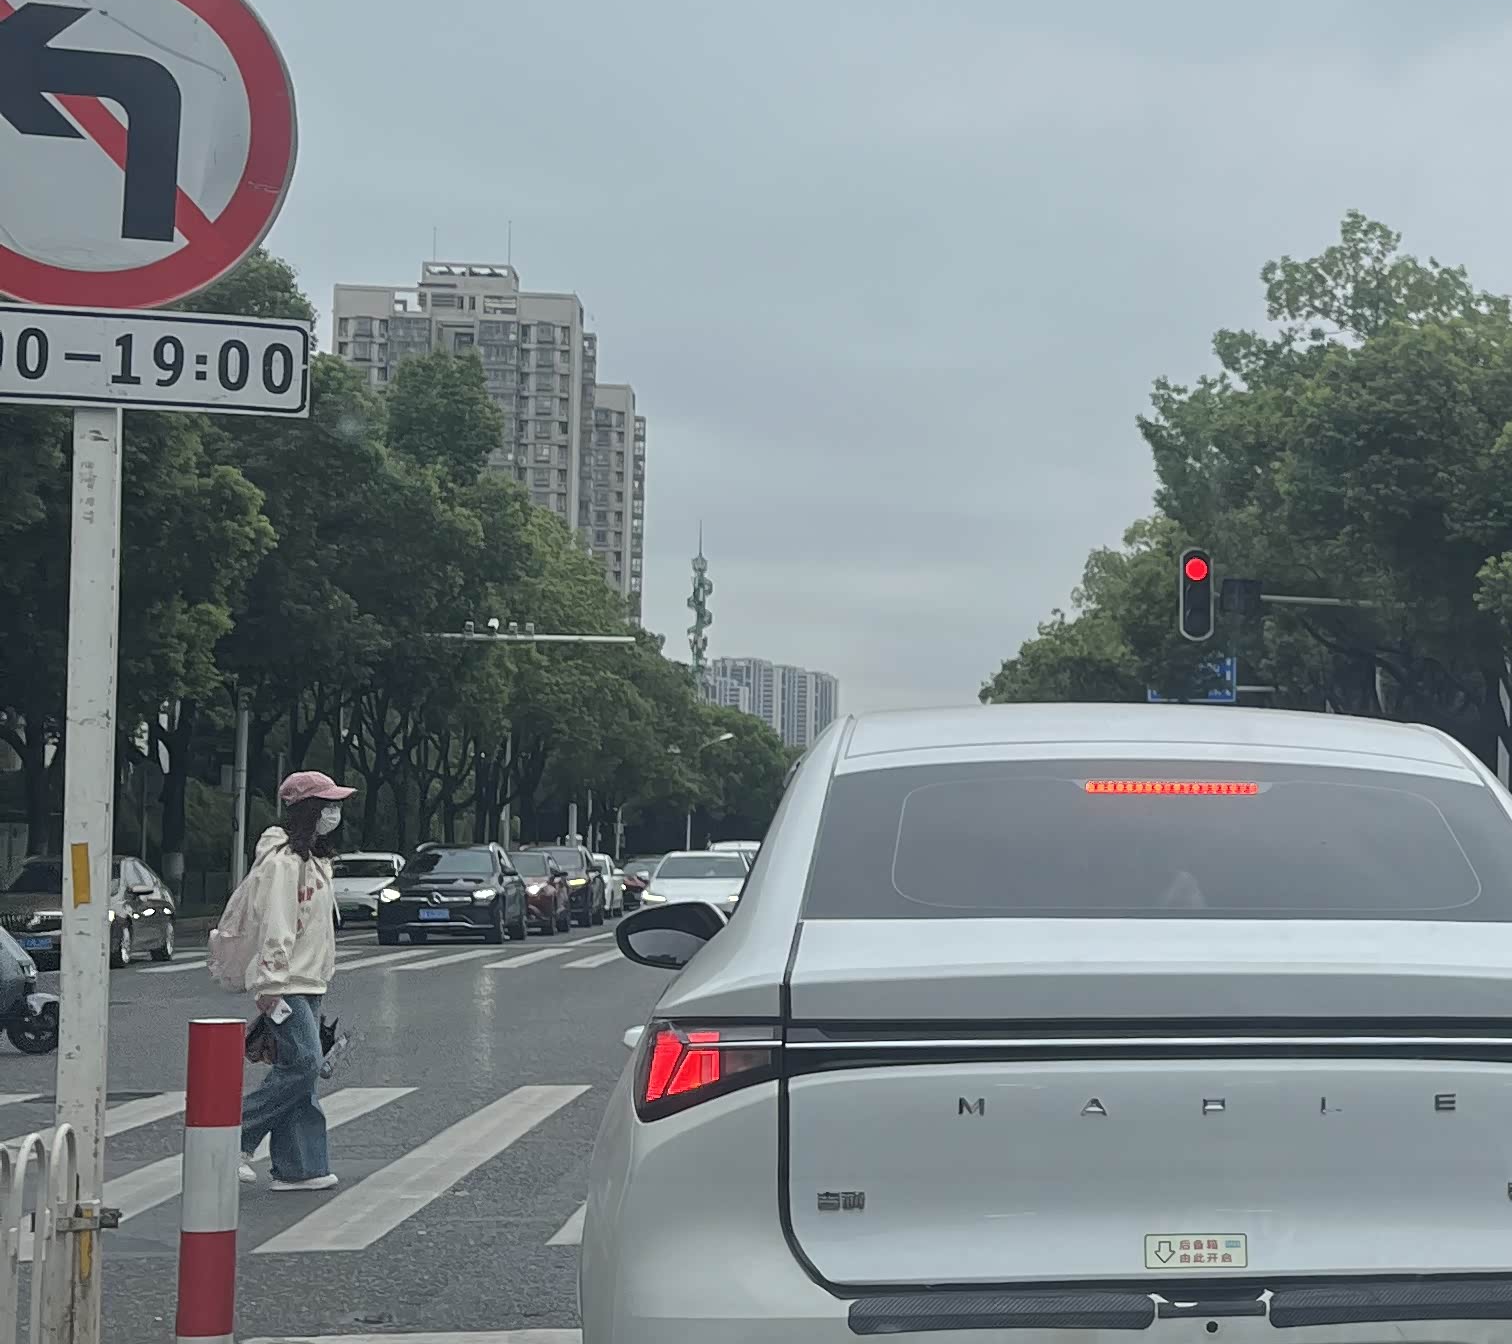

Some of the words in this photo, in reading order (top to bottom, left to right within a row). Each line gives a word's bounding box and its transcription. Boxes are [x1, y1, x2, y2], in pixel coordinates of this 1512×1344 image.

[0, 327, 294, 395] 0-19:00
[1179, 1239, 1218, 1250] 后备箱
[1179, 1252, 1232, 1263] 由此开启
